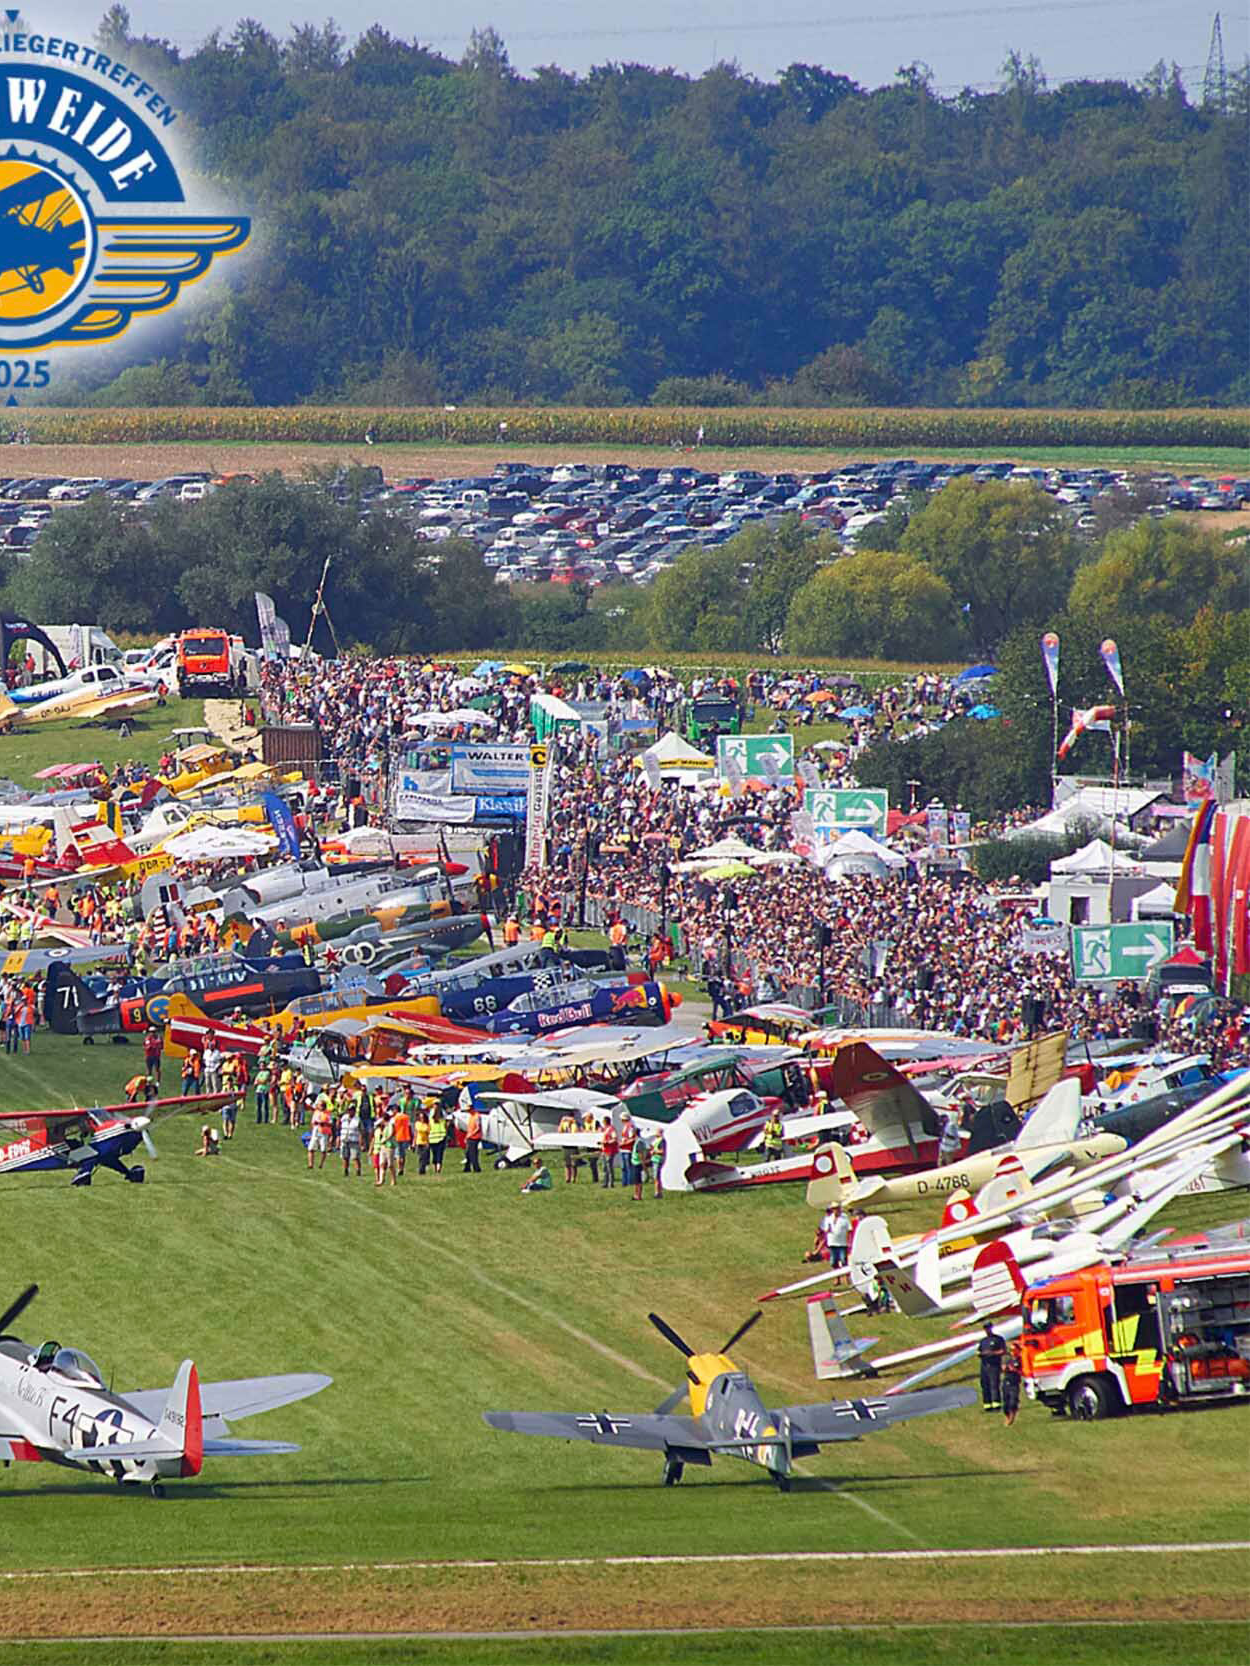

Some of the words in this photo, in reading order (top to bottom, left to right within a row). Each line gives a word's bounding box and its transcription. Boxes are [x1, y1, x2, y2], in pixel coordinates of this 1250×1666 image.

[468, 752, 524, 761] WALTER
[532, 751, 546, 765] C
[57, 986, 79, 1008] 71
[133, 1007, 142, 1022] 9
[537, 1007, 565, 1028] Red
[565, 1003, 593, 1022] Bull
[50, 1396, 81, 1445] F4
